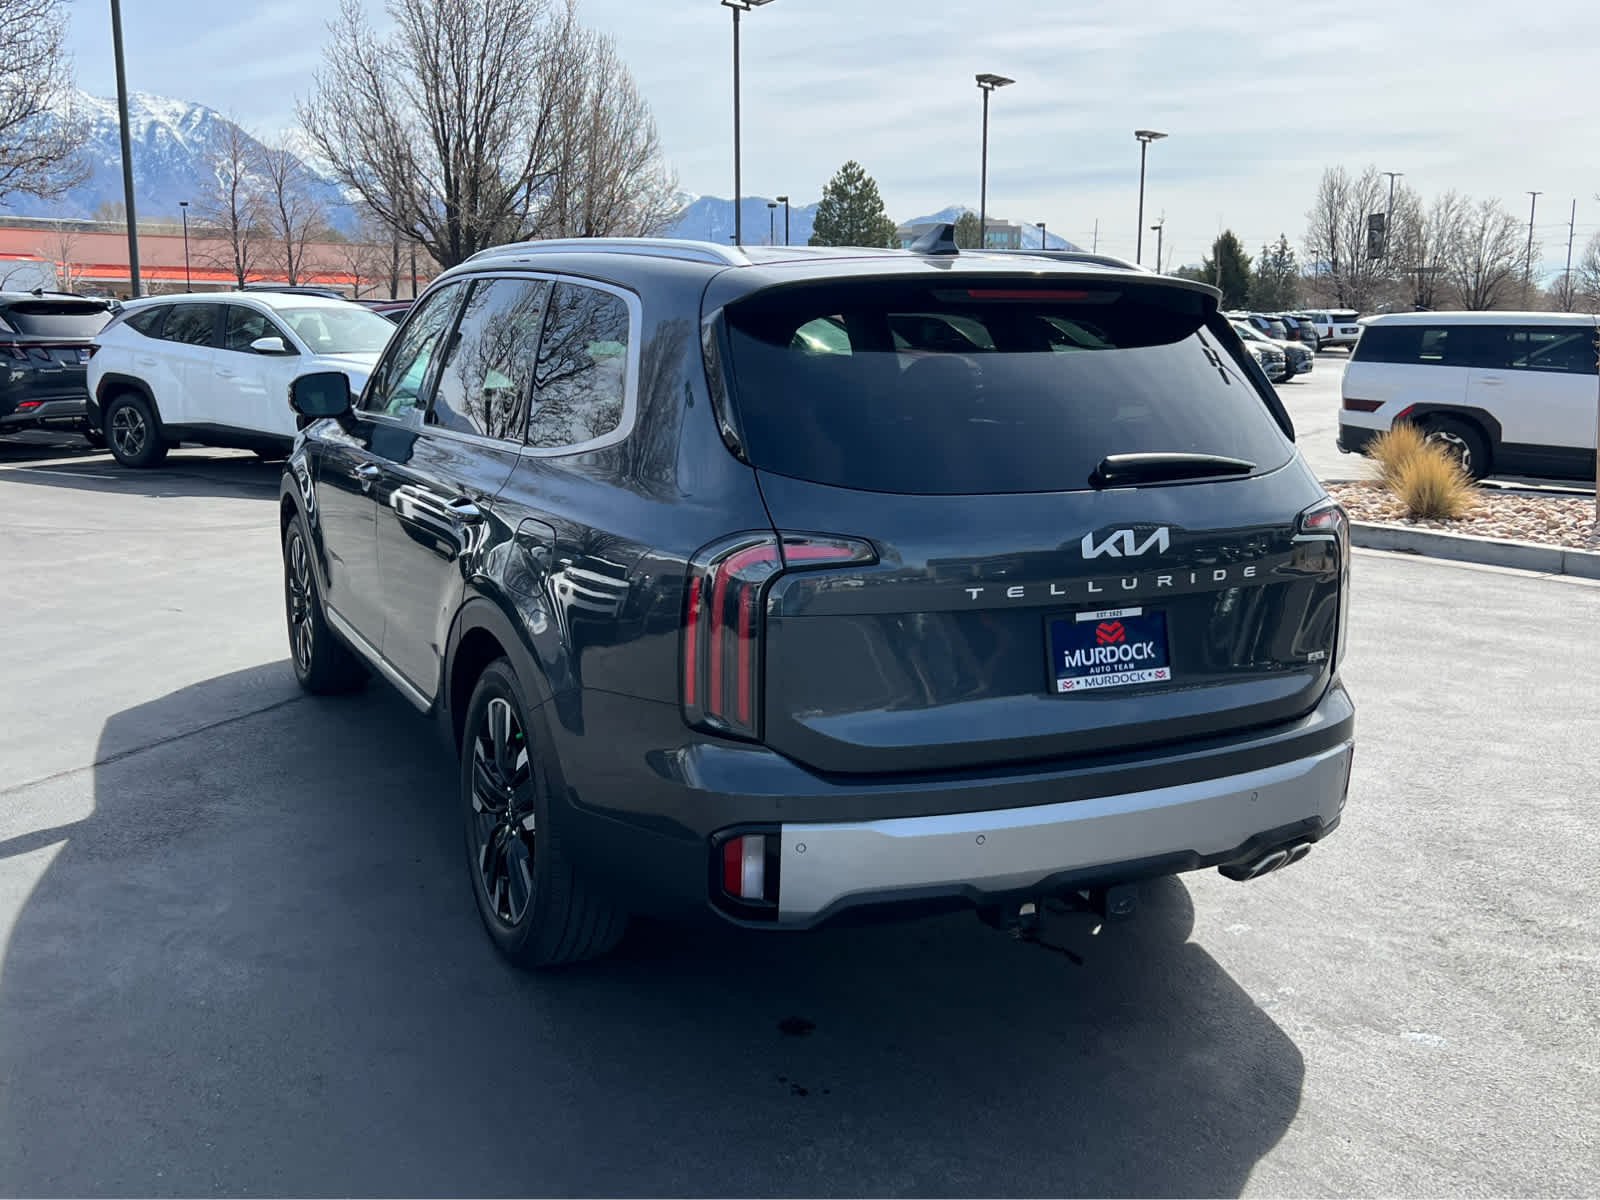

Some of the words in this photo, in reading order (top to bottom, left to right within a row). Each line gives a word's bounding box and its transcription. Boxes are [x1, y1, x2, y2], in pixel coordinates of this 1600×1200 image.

[1081, 527, 1170, 559] KIA
[965, 566, 1256, 600] TELLURIDE
[1084, 671, 1146, 688] MURDOCK
[1089, 665, 1111, 674] AUTO
[1114, 662, 1135, 672] TEAM
